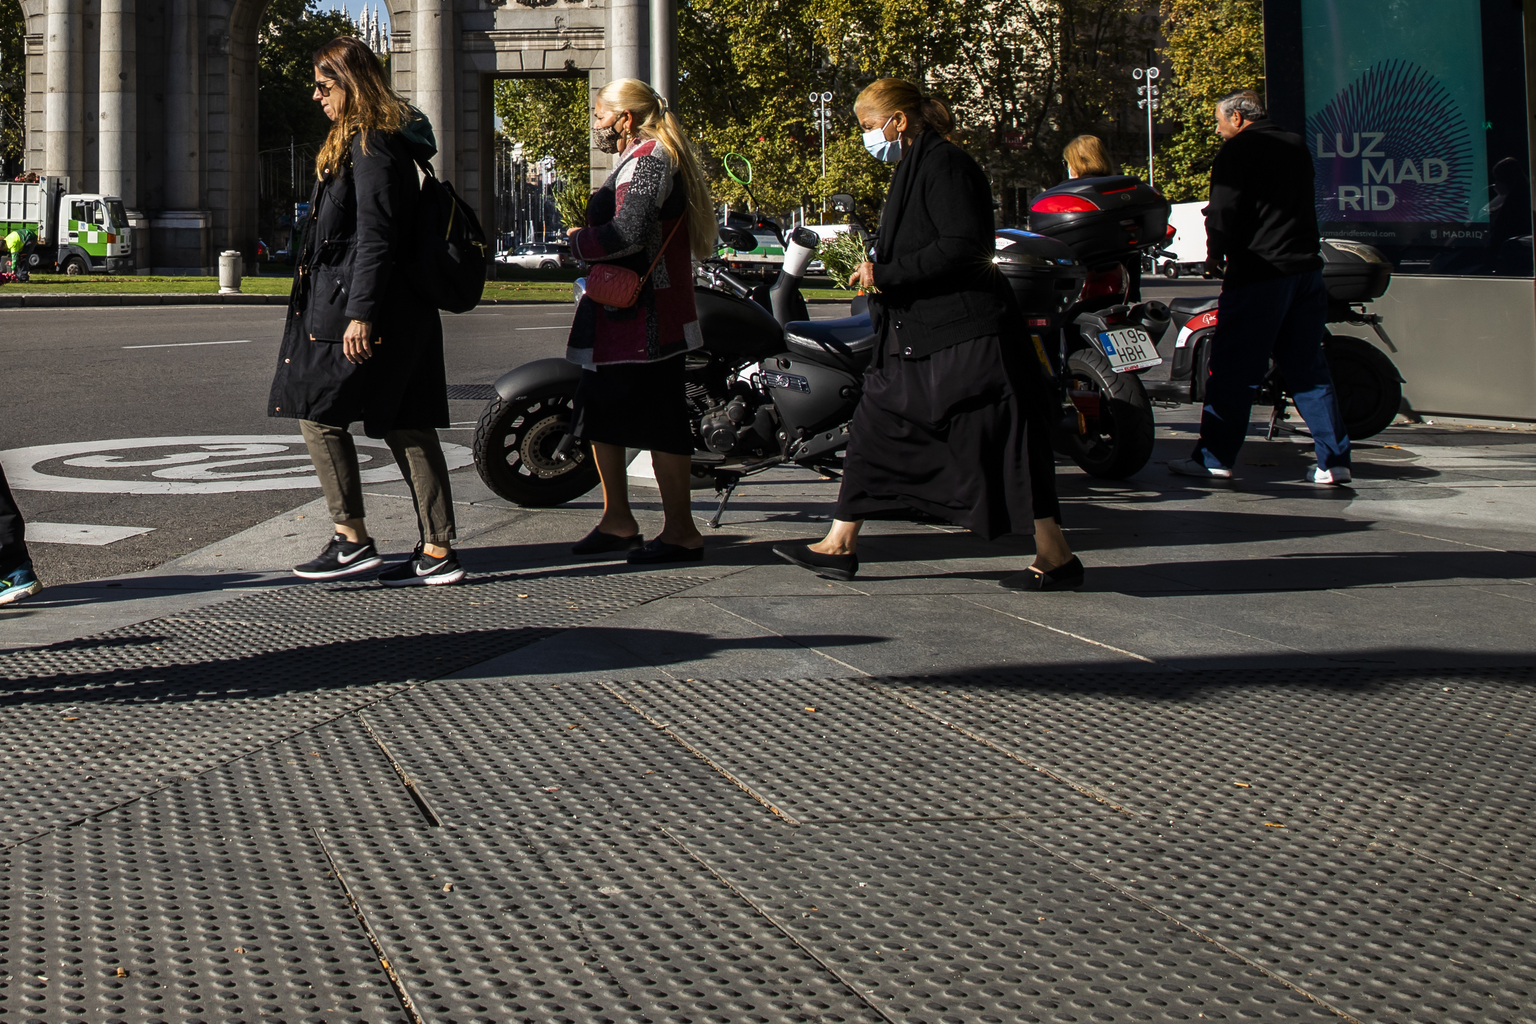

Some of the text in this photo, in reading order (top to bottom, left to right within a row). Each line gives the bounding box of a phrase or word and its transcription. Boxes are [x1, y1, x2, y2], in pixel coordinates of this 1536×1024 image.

[1316, 132, 1386, 159] LUZ
[1361, 158, 1450, 185] MAD
[1337, 184, 1397, 212] RID
[1442, 230, 1483, 239] MADRID
[1110, 328, 1147, 347] 1196
[1116, 344, 1147, 363] HBH
